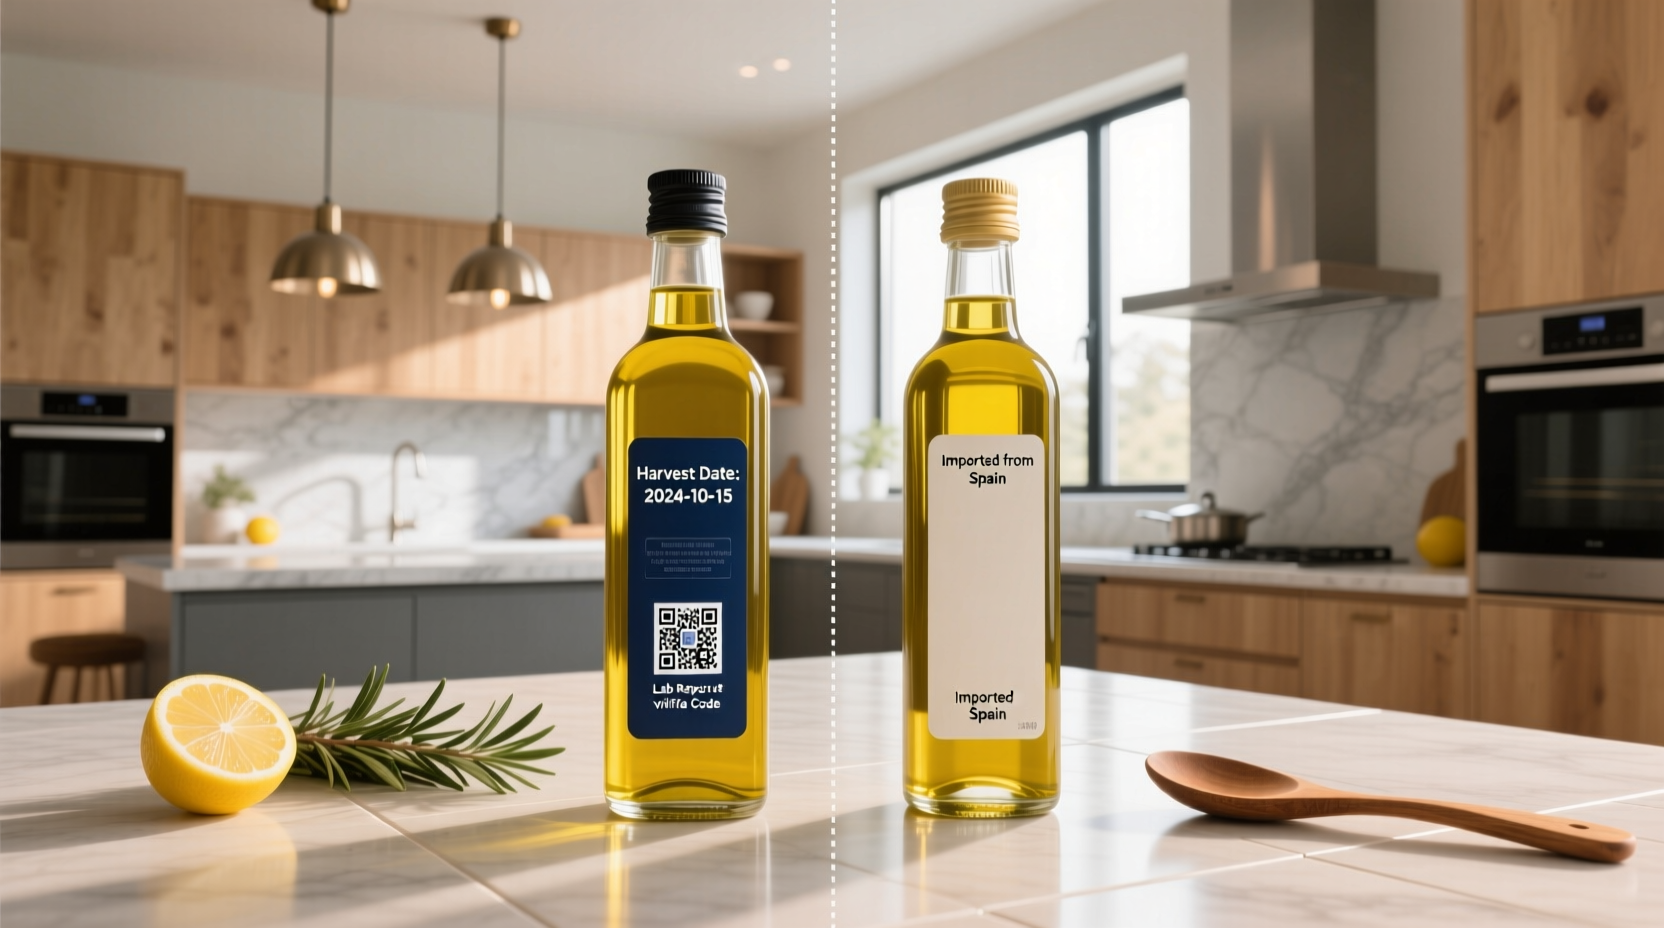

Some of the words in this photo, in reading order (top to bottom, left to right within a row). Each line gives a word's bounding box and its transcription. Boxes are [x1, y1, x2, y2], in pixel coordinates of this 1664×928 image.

[942, 454, 1000, 470] Imported
[1003, 453, 1034, 467] from
[637, 466, 696, 481] Harvest
[699, 466, 740, 481] Date:
[969, 472, 1007, 488] Spain
[644, 488, 733, 504] 2024-10-15
[955, 690, 1014, 706] Imported
[969, 707, 1007, 723] Spain
